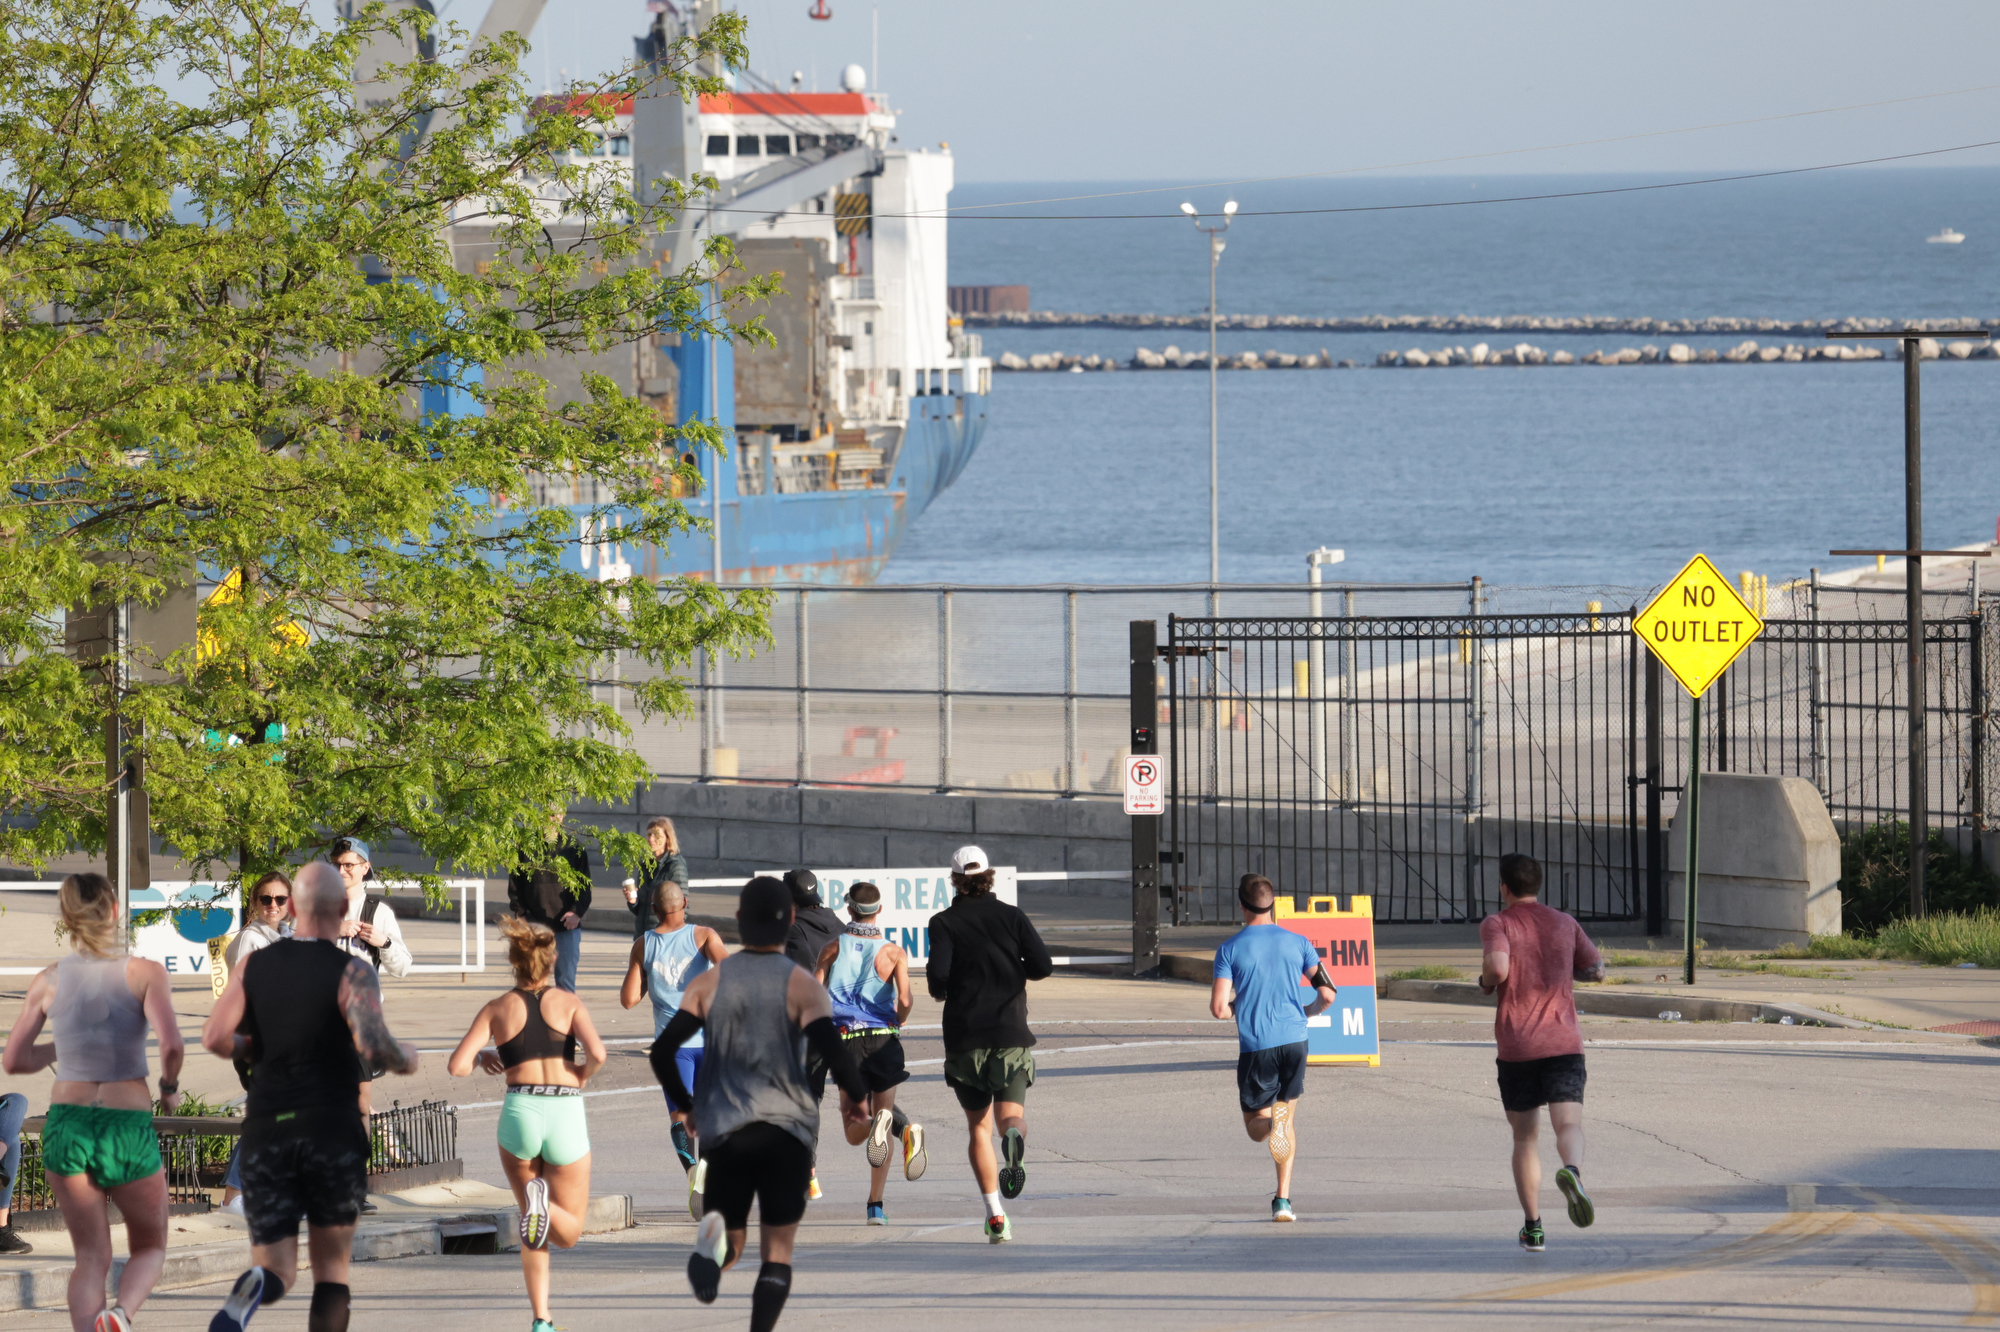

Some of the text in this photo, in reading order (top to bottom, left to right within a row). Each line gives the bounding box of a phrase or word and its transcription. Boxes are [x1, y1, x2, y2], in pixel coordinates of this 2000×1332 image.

[1683, 585, 1715, 607] NO
[1654, 620, 1744, 642] OUTLET
[894, 877, 957, 910] REA
[1330, 940, 1369, 966] HM
[209, 939, 225, 998] COURSE
[1342, 1008, 1365, 1036] M
